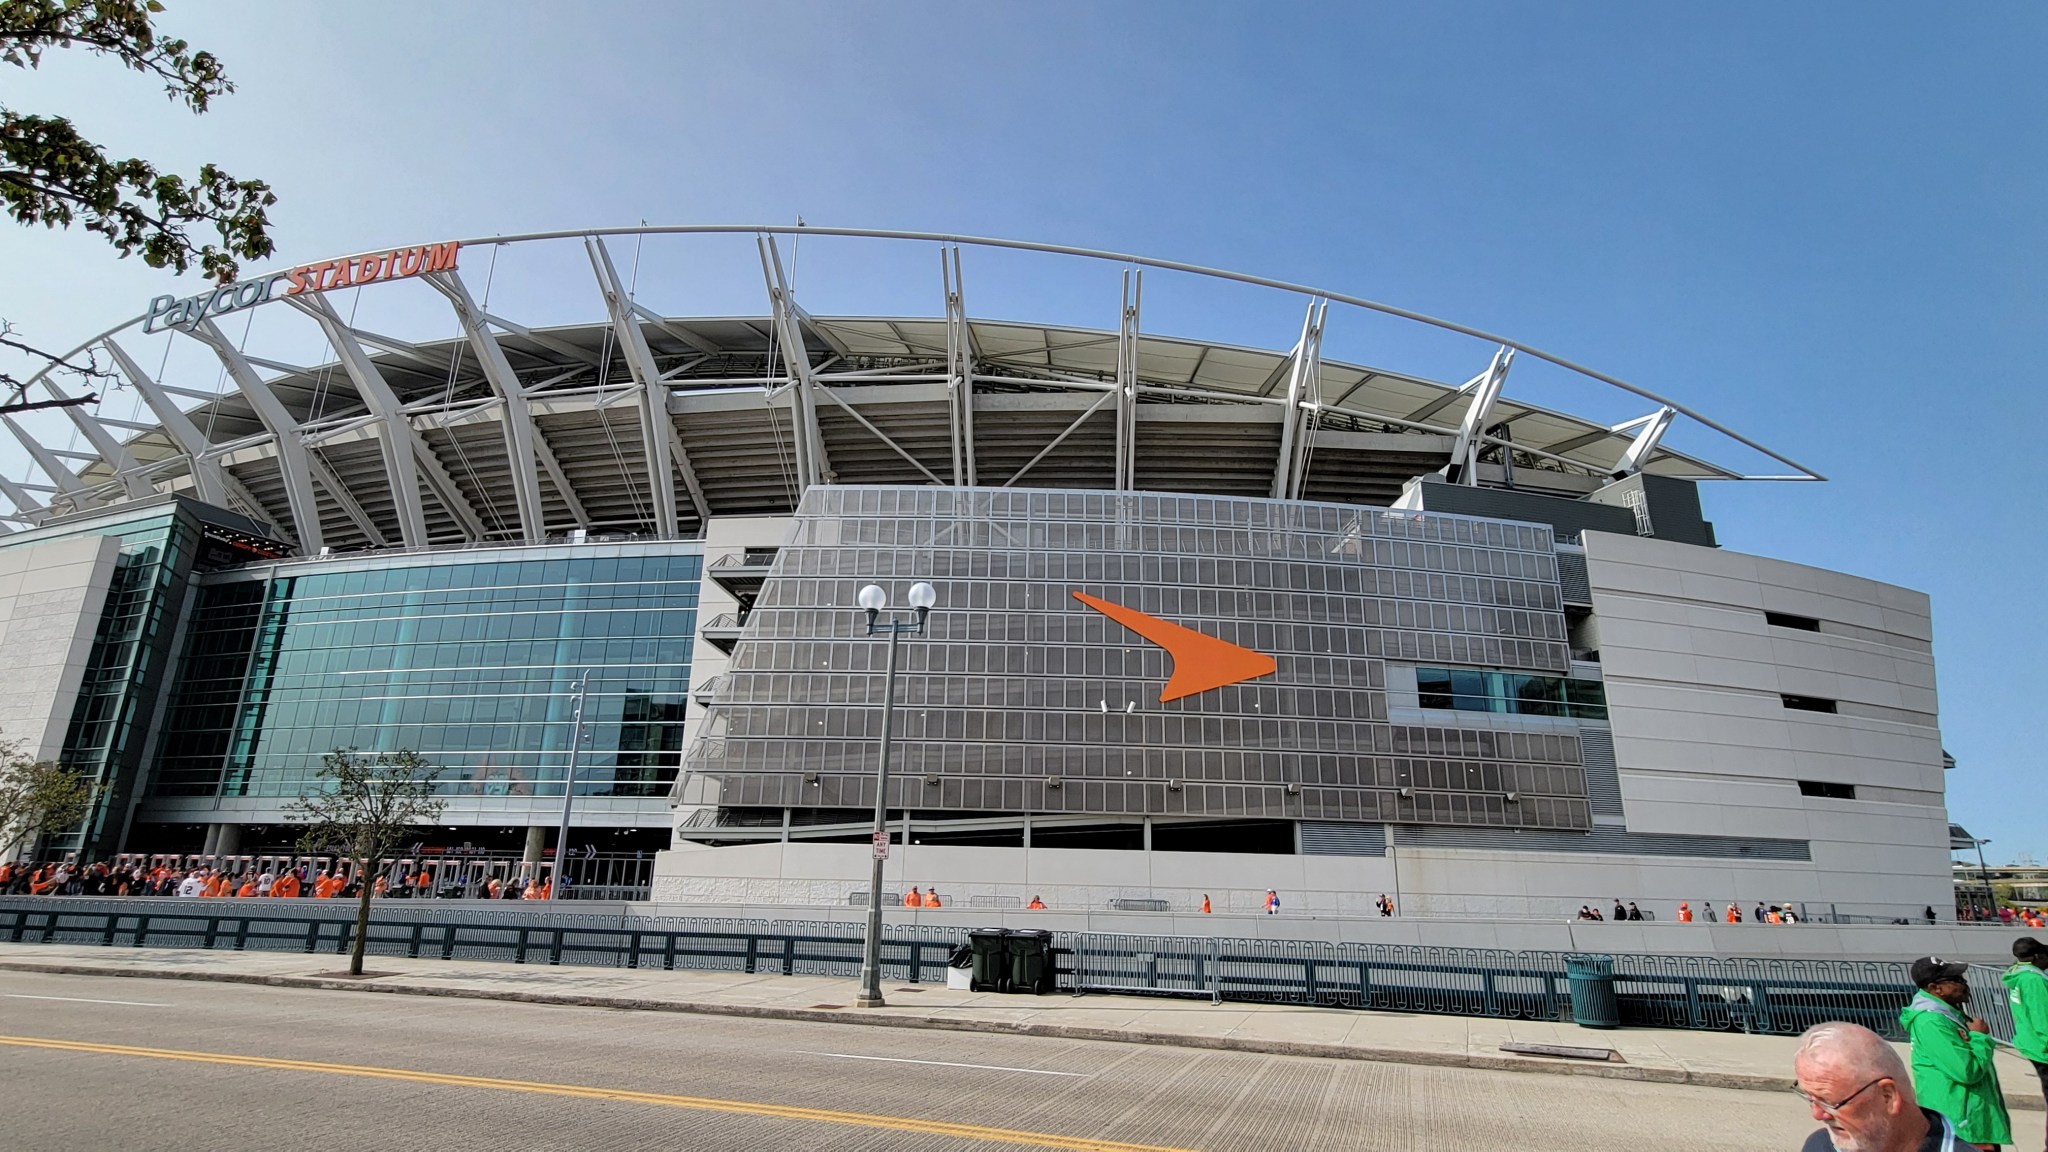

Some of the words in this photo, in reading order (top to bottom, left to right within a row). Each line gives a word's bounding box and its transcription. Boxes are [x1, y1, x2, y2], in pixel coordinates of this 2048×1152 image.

[142, 273, 286, 334] Paycor
[287, 241, 459, 296] STADIUM
[184, 885, 193, 895] 12
